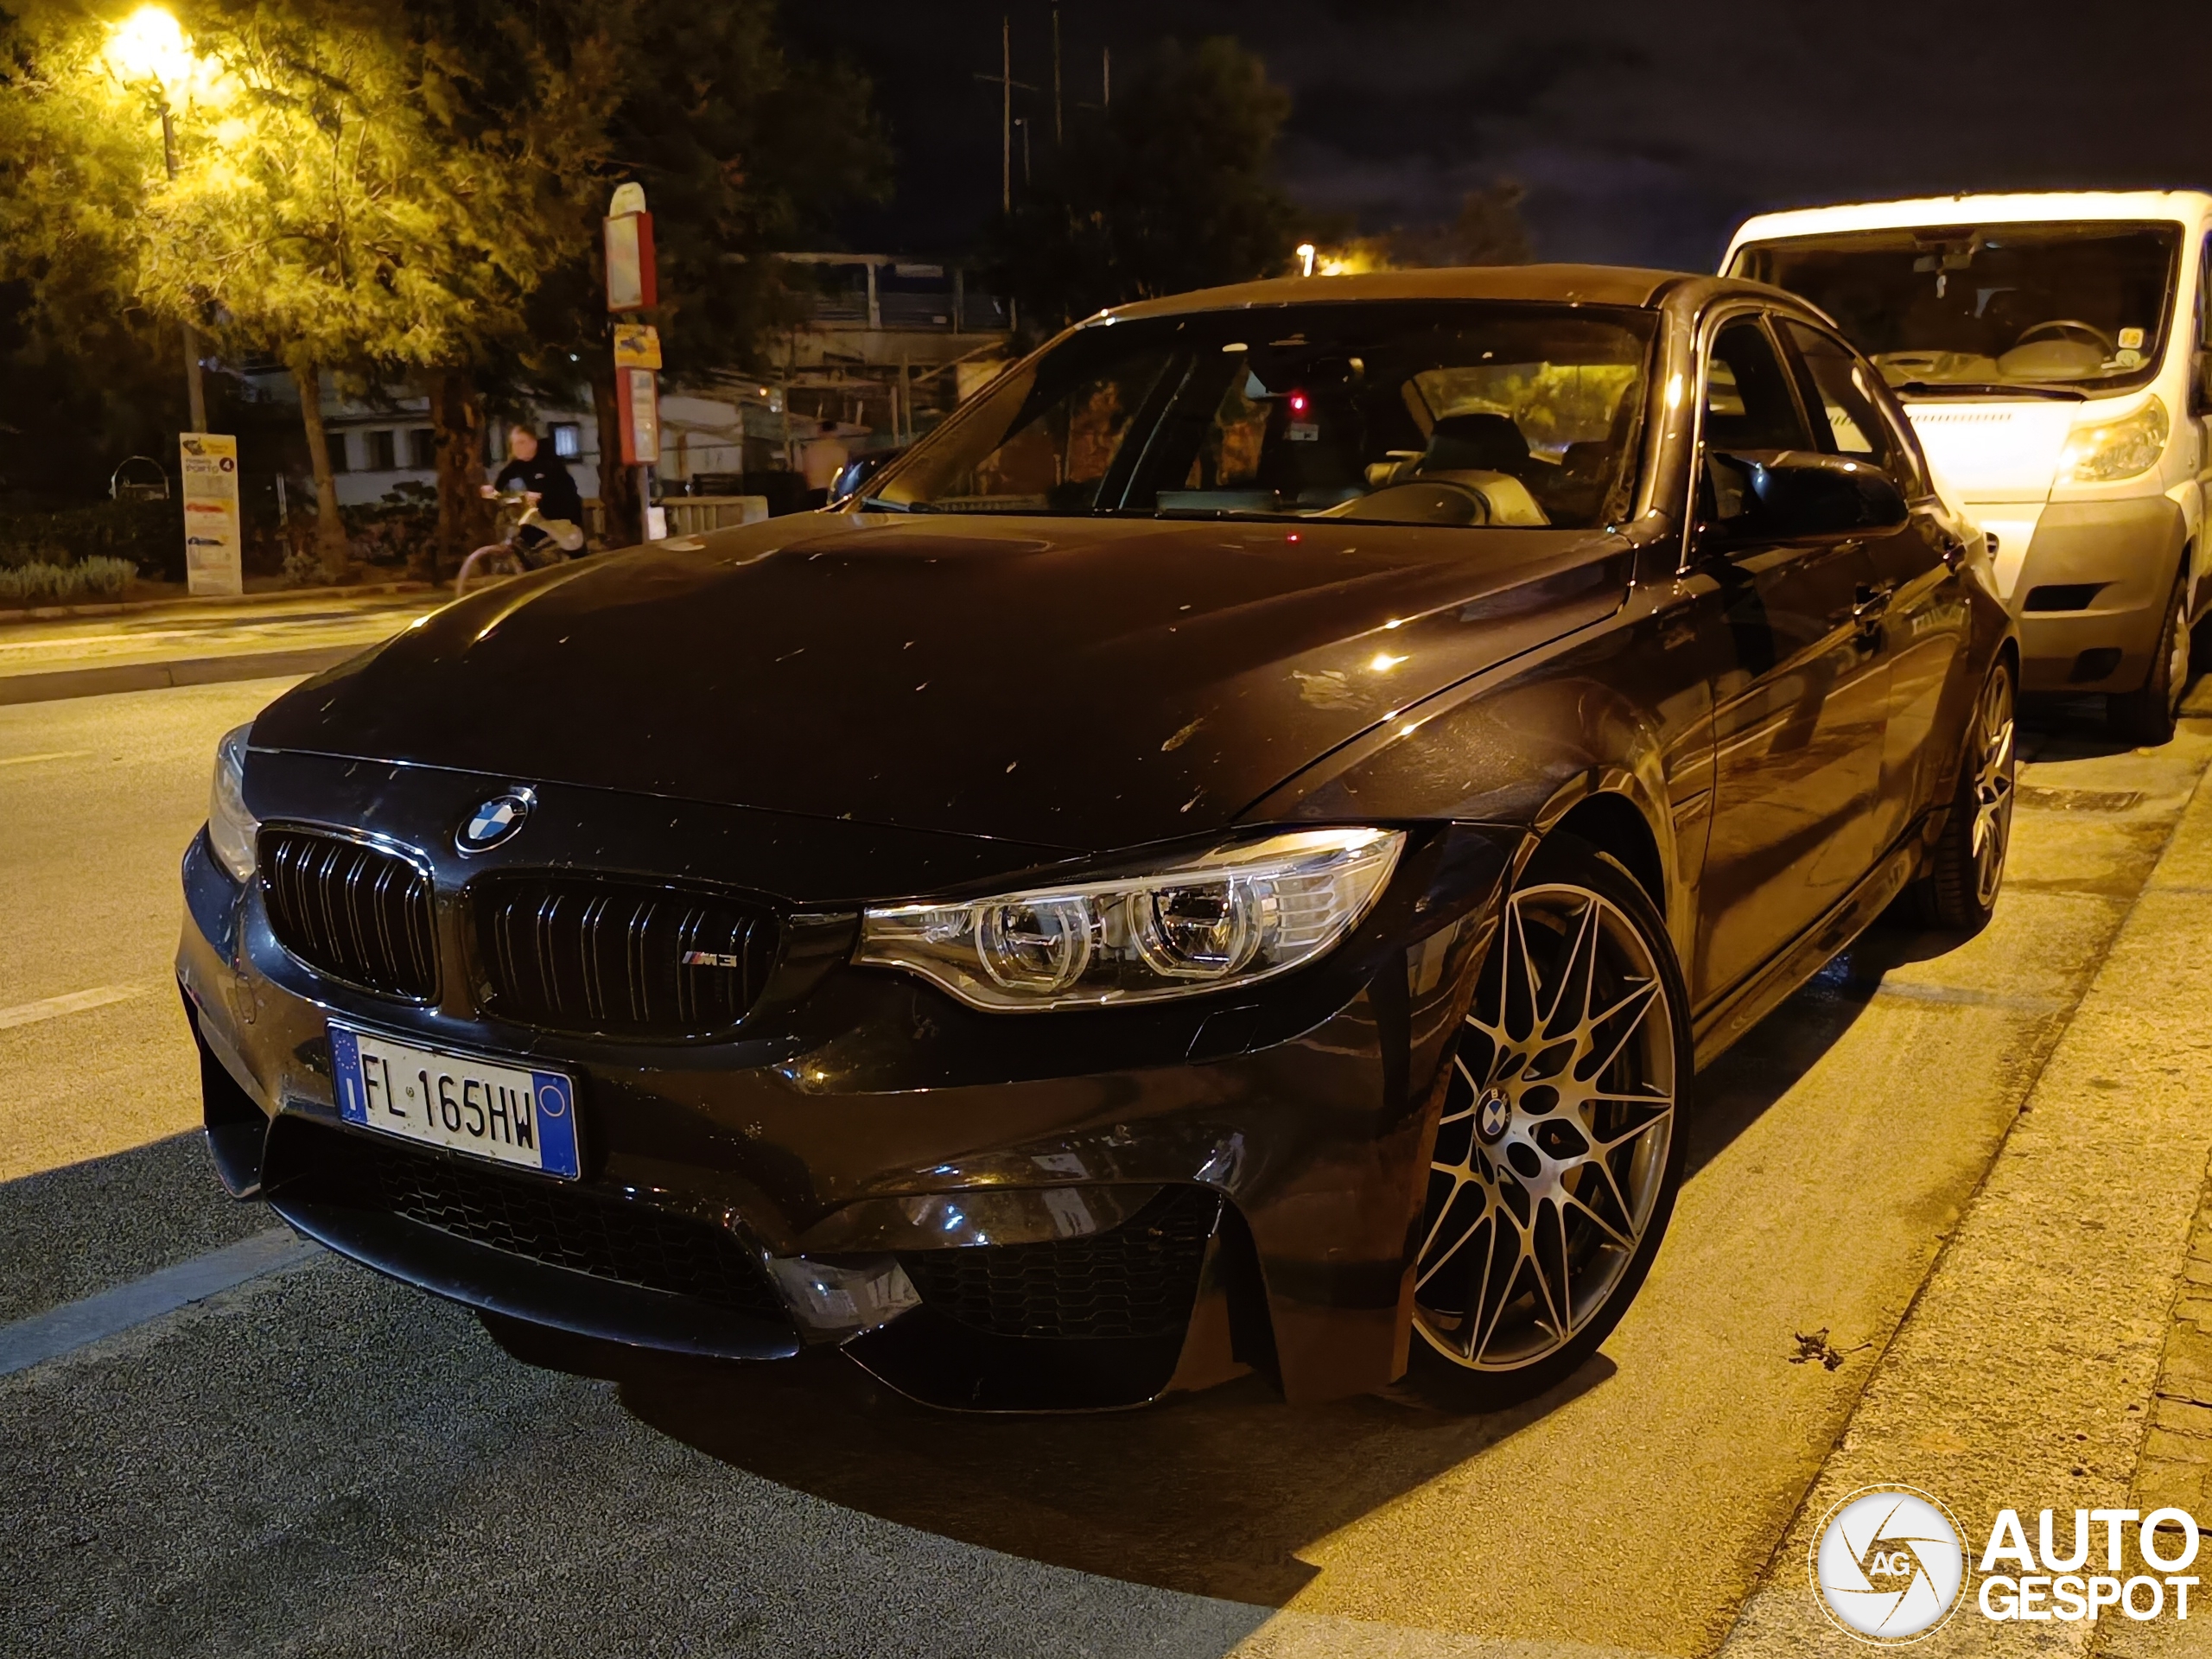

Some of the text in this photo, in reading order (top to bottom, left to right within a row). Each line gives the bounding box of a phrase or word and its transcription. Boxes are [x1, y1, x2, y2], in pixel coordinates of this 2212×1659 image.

[694, 951, 737, 968] M3
[361, 1053, 535, 1149] FL 165HW
